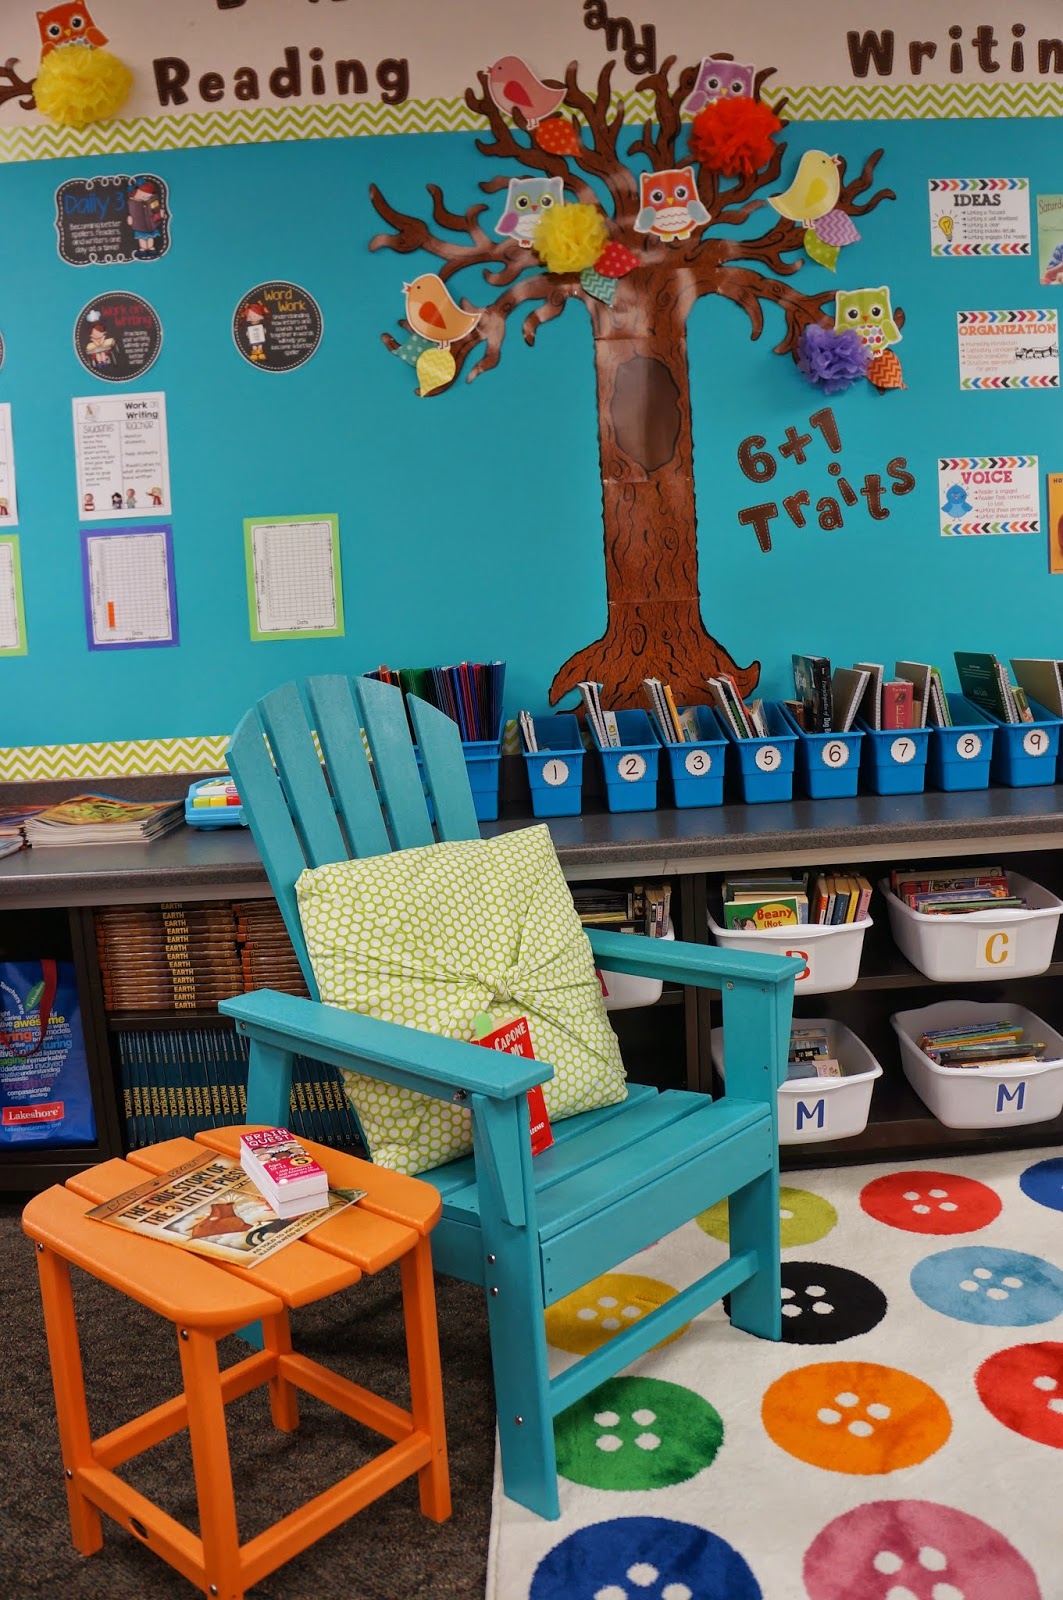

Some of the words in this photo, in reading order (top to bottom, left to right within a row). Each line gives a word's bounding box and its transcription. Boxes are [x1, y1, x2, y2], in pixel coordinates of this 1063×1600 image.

[583, 0, 656, 74] and
[847, 23, 1063, 77] Writin
[152, 46, 409, 106] Reading
[115, 191, 126, 211] 3
[953, 194, 1002, 206] IDEAS
[264, 288, 293, 301] Word
[277, 300, 306, 312] Work
[959, 324, 1056, 336] ORGANIZATION
[125, 401, 147, 410] Work
[126, 411, 158, 420] Writing
[738, 407, 842, 484] 6+1
[961, 470, 1012, 484] VOICE
[738, 456, 916, 553] Traits
[823, 717, 831, 728] Dog
[829, 745, 841, 763] 6
[898, 743, 909, 757] 7
[964, 739, 974, 753] 8
[1030, 734, 1042, 750] 9
[625, 758, 639, 775] 2
[693, 755, 705, 770] 3
[763, 751, 774, 765] 5
[553, 764, 558, 780] 1
[756, 908, 793, 921] Beany
[764, 920, 782, 928] (Not
[985, 932, 1009, 965] C
[0, 981, 21, 1004] Teachers
[13, 1016, 65, 1028] awesme
[495, 1022, 527, 1052] CAPONE
[20, 1067, 60, 1076] understanding
[27, 1055, 66, 1064] remarkable
[35, 1060, 63, 1068] involved
[3, 1078, 54, 1090] creative
[7, 1087, 51, 1096] compassionate
[295, 1082, 307, 1112] PHYSICAL
[304, 1082, 317, 1112] PHYSICAL
[313, 1082, 325, 1112] PHYSICAL
[322, 1081, 335, 1111] PHYSICAL
[331, 1081, 344, 1111] PHYSICAL
[123, 1089, 132, 1119] PHYSICAL
[133, 1087, 142, 1117] PHYSICAL
[141, 1087, 151, 1116] PHYSICAL
[150, 1087, 160, 1116] PHYSICAL
[159, 1087, 169, 1117] PHYSICAL
[168, 1087, 178, 1117] PHYSICAL
[176, 1087, 185, 1117] PHYSICAL
[185, 1087, 195, 1117] PHYSICAL
[193, 1087, 203, 1116] PHYSICAL
[201, 1086, 212, 1116] PHYSICAL
[211, 1085, 221, 1115] PHYSICAL
[220, 1085, 231, 1116] PHYSICAL
[229, 1085, 240, 1115] PHYSICAL
[996, 1082, 1026, 1113] M
[8, 1107, 58, 1120] Lakeshore
[796, 1098, 825, 1131] M
[245, 1129, 287, 1142] BRAIN
[248, 1135, 290, 1147] QUEST
[118, 1202, 153, 1220] THE
[145, 1188, 177, 1207] TRUE
[172, 1170, 213, 1194] STORY
[206, 1163, 228, 1175] OF
[139, 1210, 172, 1226] THE
[167, 1204, 184, 1213] 3
[179, 1184, 221, 1207] LITTLE
